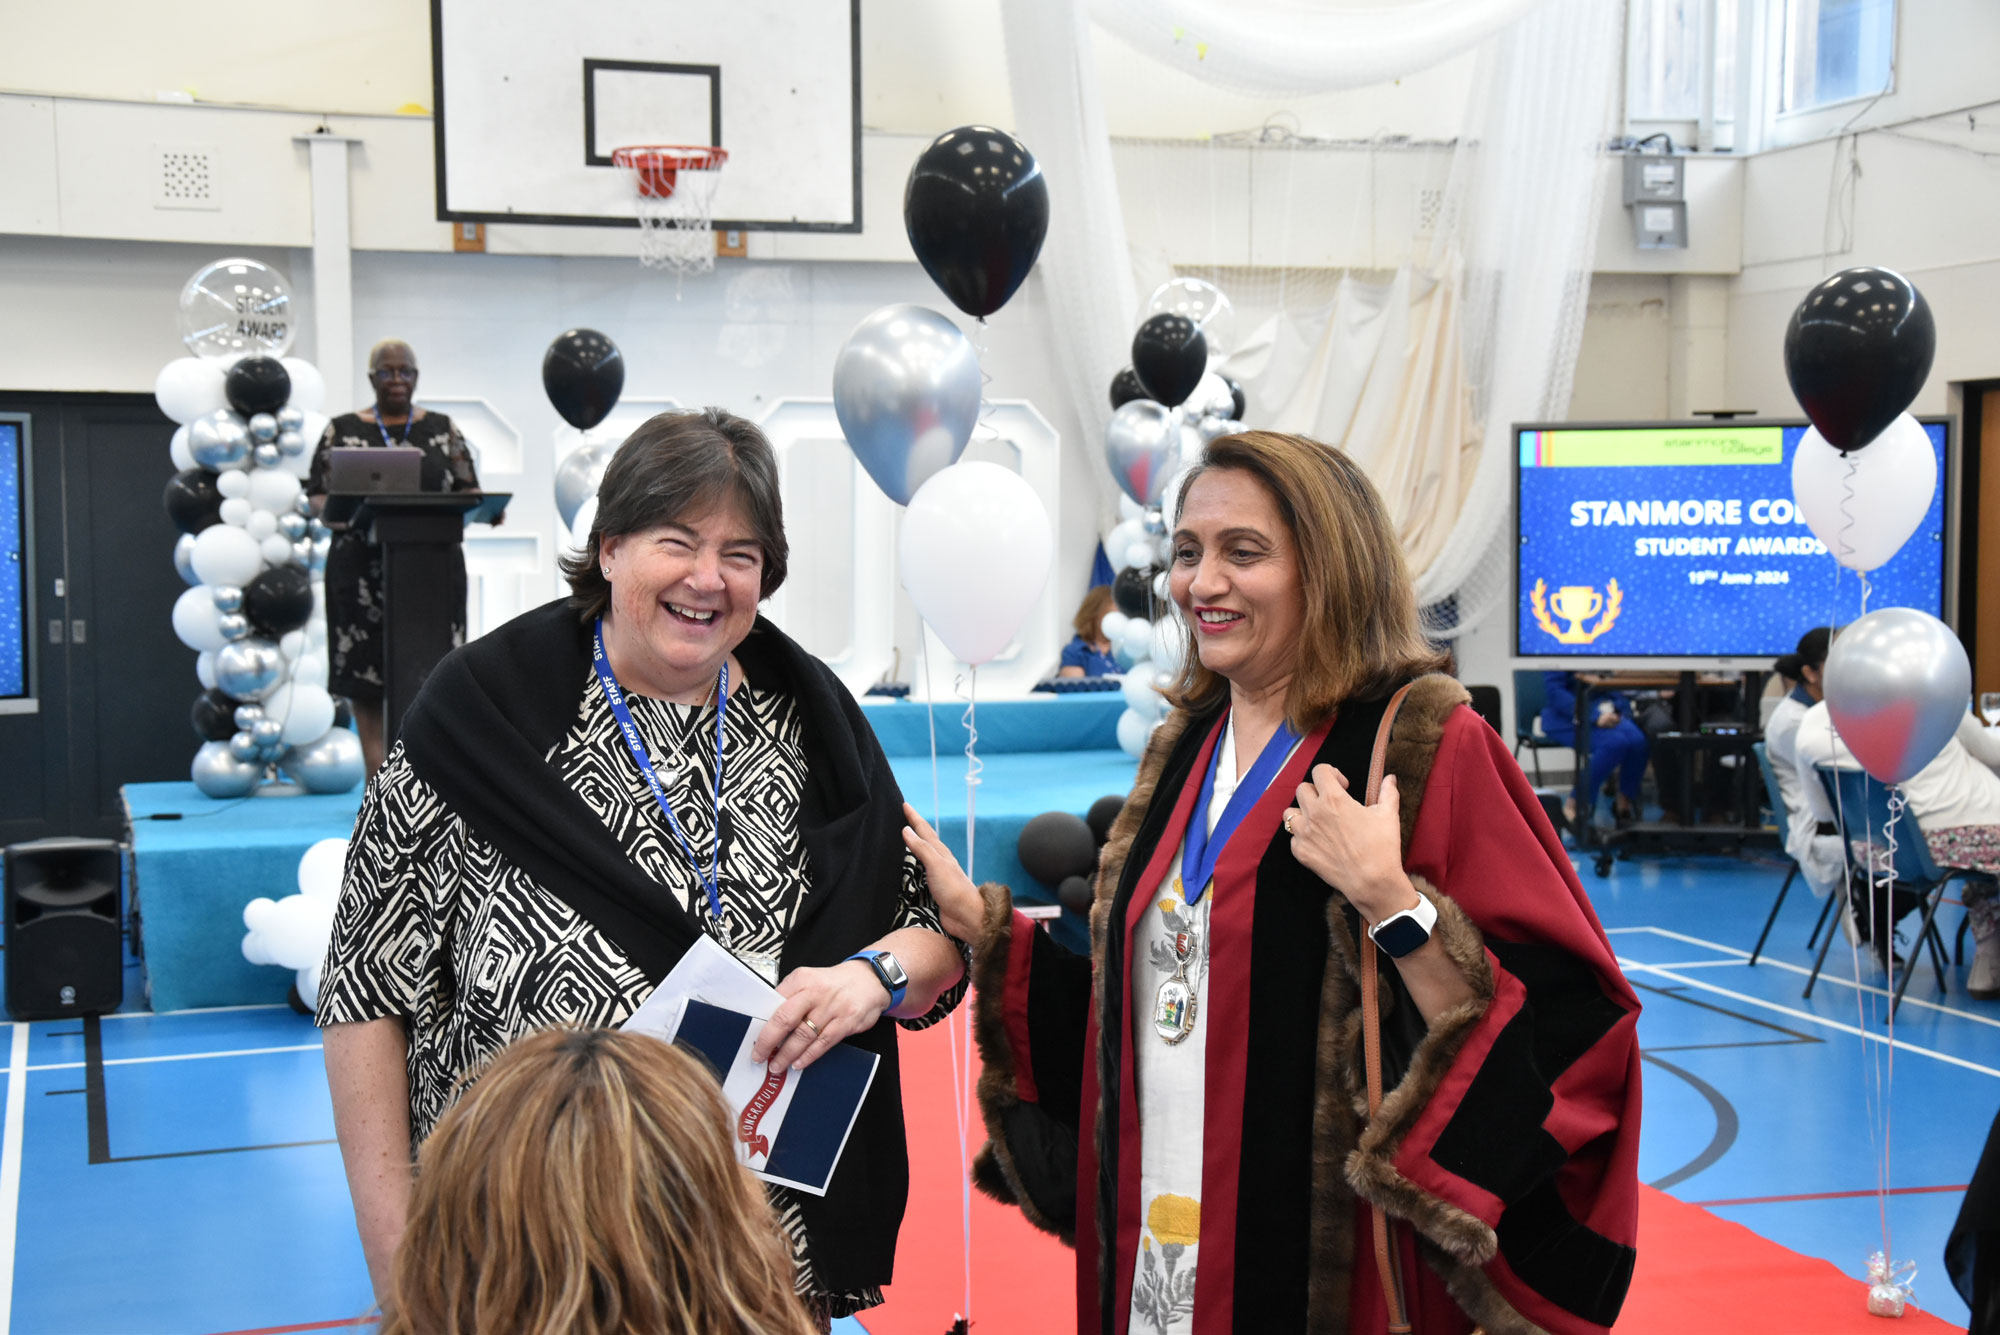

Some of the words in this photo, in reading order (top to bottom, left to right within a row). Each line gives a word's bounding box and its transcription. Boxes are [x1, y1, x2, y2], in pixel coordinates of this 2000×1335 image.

[1570, 499, 1743, 527] STANMORE
[1635, 537, 1732, 557] STUDENT
[1734, 536, 1828, 556] AWARDS
[1719, 571, 1753, 585] June
[1755, 570, 1789, 585] 2024
[602, 676, 622, 705] STAFF
[622, 721, 641, 751] STAFF
[643, 767, 662, 797] STAFF
